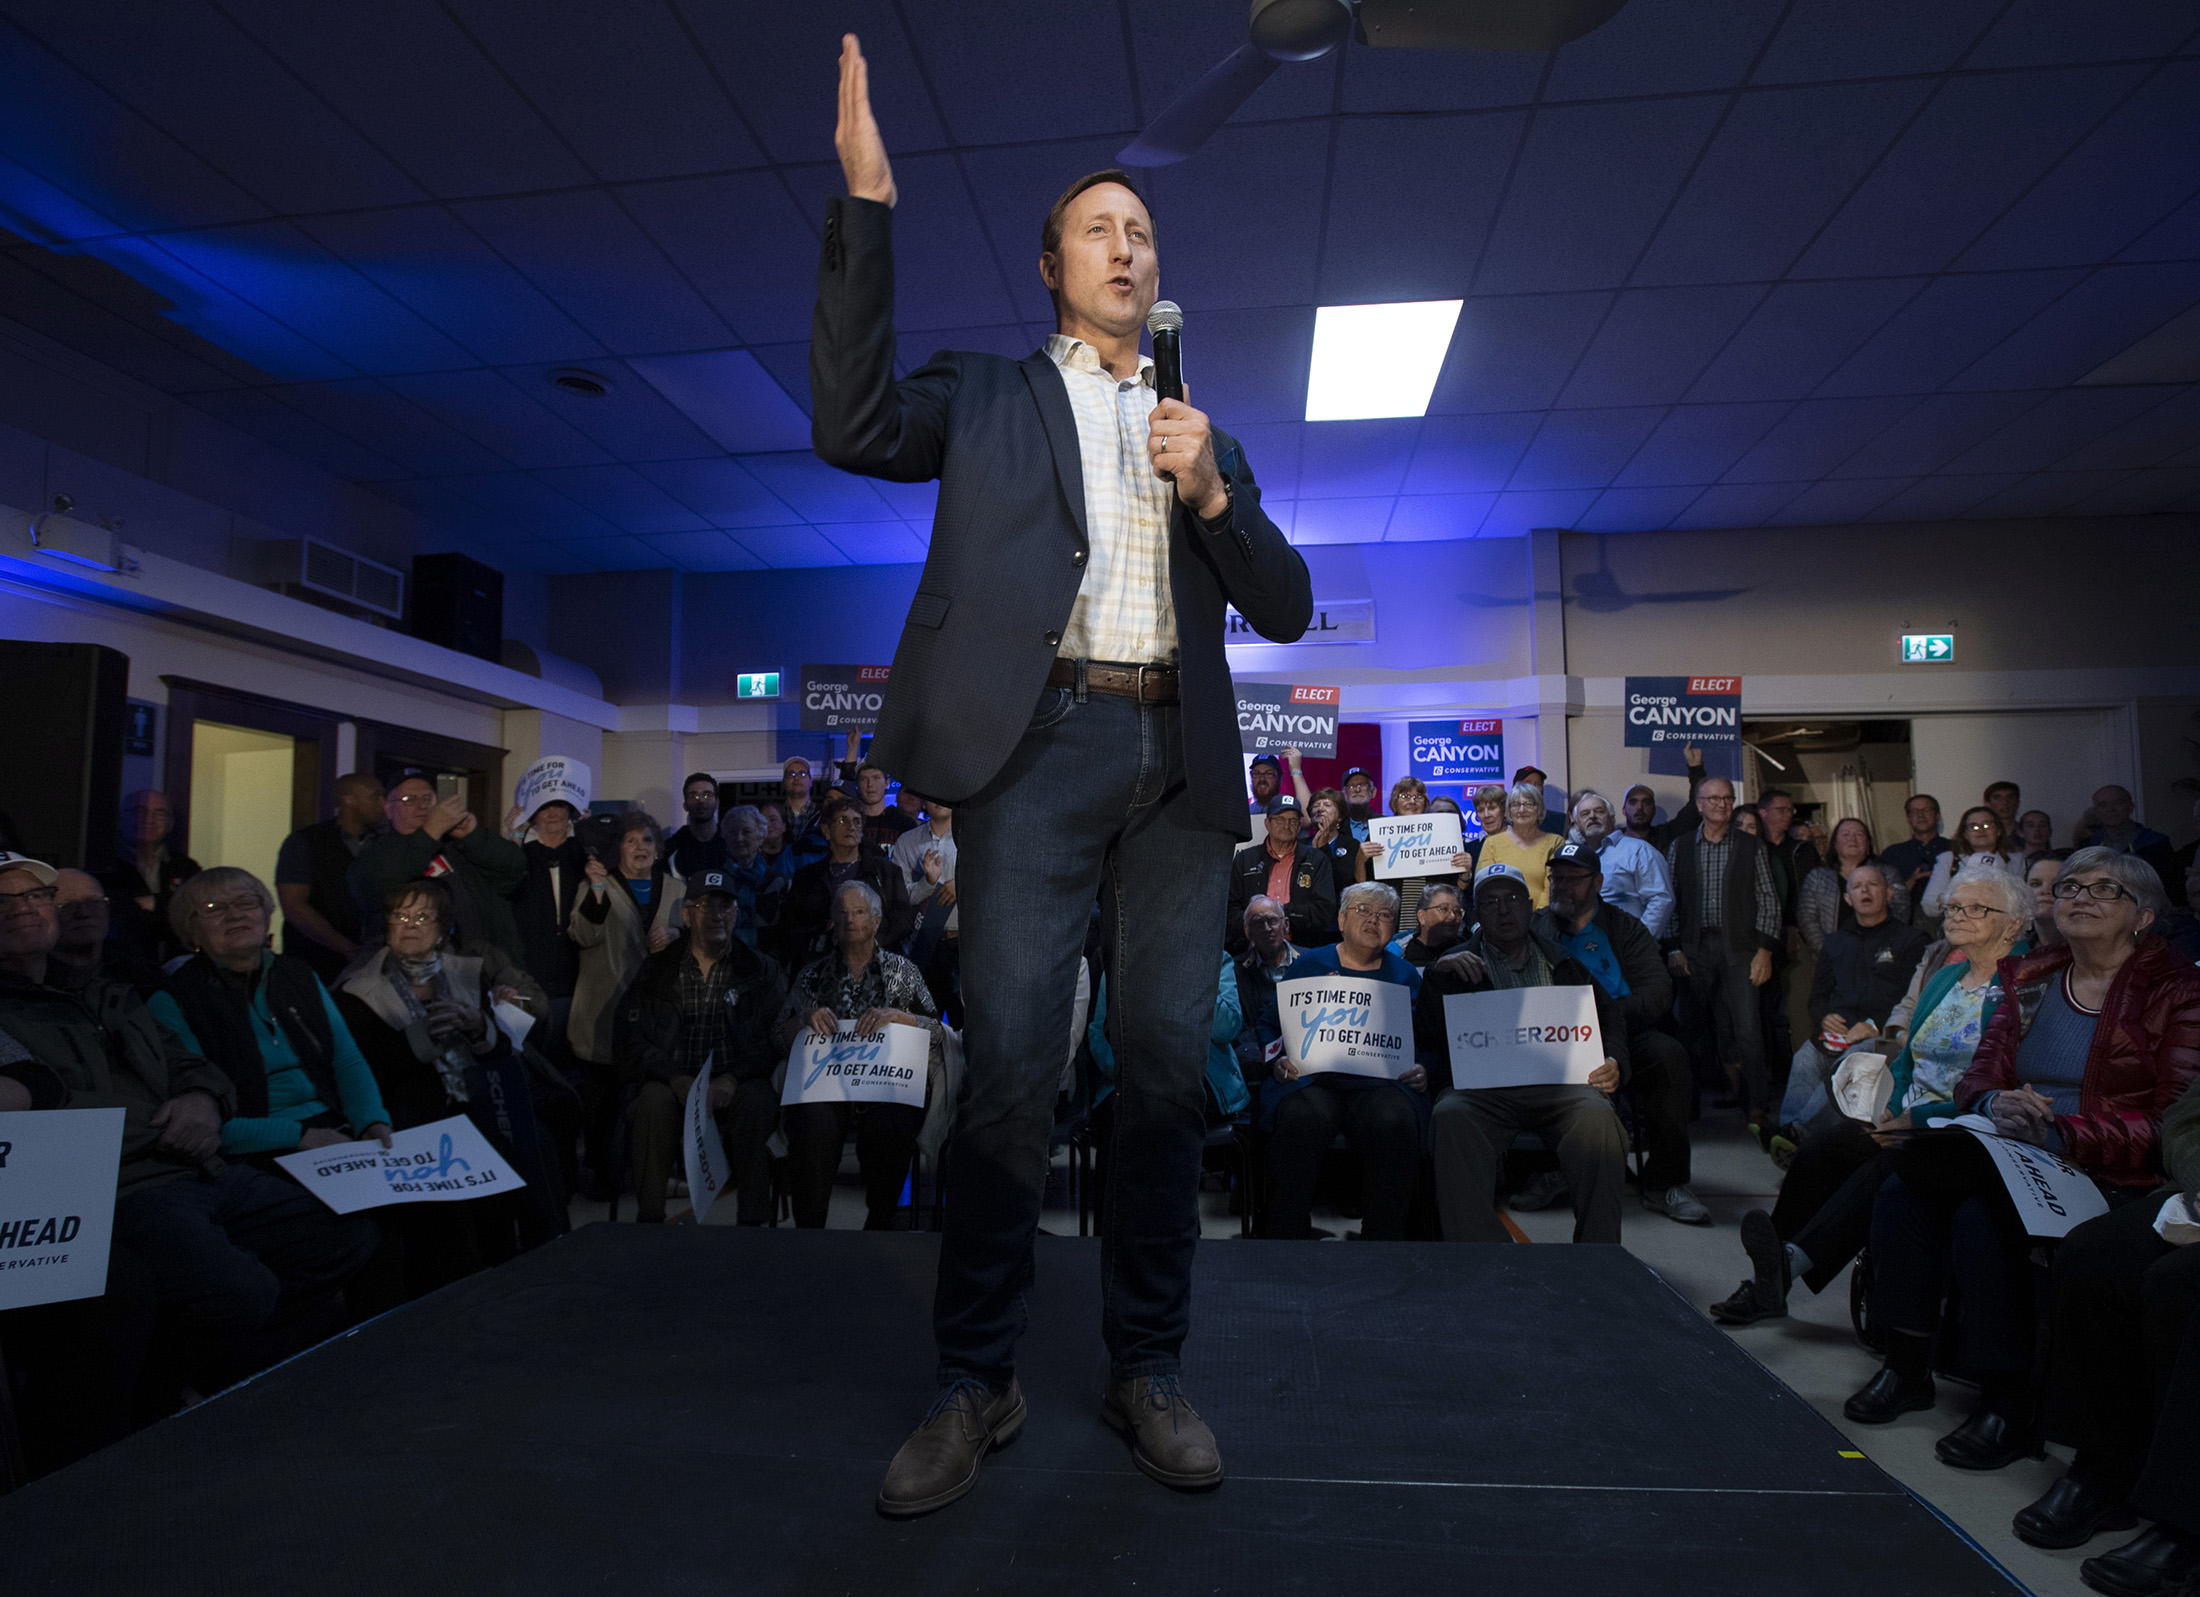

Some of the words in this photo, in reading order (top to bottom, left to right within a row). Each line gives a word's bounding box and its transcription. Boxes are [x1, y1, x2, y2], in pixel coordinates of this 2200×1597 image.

[860, 668, 891, 679] ELEC
[806, 681, 849, 693] George
[1691, 679, 1735, 691] ELECT
[805, 692, 884, 711] CANYO
[1294, 688, 1334, 701] ELECT
[1630, 693, 1677, 707] George
[1237, 700, 1281, 714] George
[1629, 706, 1736, 726] CANYON
[1237, 712, 1334, 735] CANYON
[1462, 721, 1496, 732] ELECT
[1413, 736, 1452, 747] George
[1666, 732, 1735, 741] CONSERVATIVE
[1269, 739, 1333, 750] CONSERVATIVE
[1413, 744, 1499, 762] CANYON
[546, 761, 565, 769] FOR
[1444, 766, 1500, 774] CONSERVATIVE
[542, 779, 558, 790] GET
[1379, 825, 1395, 836] IT'S
[1396, 823, 1415, 834] TIME
[1417, 822, 1433, 832] FOR
[1387, 833, 1432, 869] you
[1400, 849, 1410, 859] TO
[1411, 847, 1427, 858] GET
[1429, 845, 1458, 857] AHEAD
[1290, 991, 1313, 1007] IT'S
[1316, 990, 1346, 1004] TIME
[1349, 991, 1372, 1006] FOR
[804, 1032, 827, 1046] IT'S
[830, 1030, 858, 1044] TIME
[1300, 1007, 1370, 1061] you
[1319, 1028, 1335, 1043] TO
[1338, 1029, 1361, 1044] GET
[1363, 1034, 1402, 1050] AHEAD
[1357, 1050, 1400, 1061] CONSERVATIVE
[803, 1044, 881, 1091] you
[826, 1064, 841, 1076] TO
[843, 1063, 868, 1076] GET
[869, 1065, 914, 1080] AHEAD
[861, 1080, 909, 1088] CONSERVATIVE
[383, 1157, 411, 1167] GET
[384, 1133, 471, 1181] you
[413, 1151, 437, 1165] TO
[317, 1158, 377, 1177] AHEAD
[2047, 1153, 2076, 1177] OR
[465, 1170, 497, 1186] IT'S
[2013, 1150, 2067, 1217] AHEAD
[389, 1181, 423, 1192] FOR
[424, 1179, 464, 1192] TIME
[0, 1215, 81, 1249] HEAD
[0, 1254, 69, 1270] ERVATIVE
